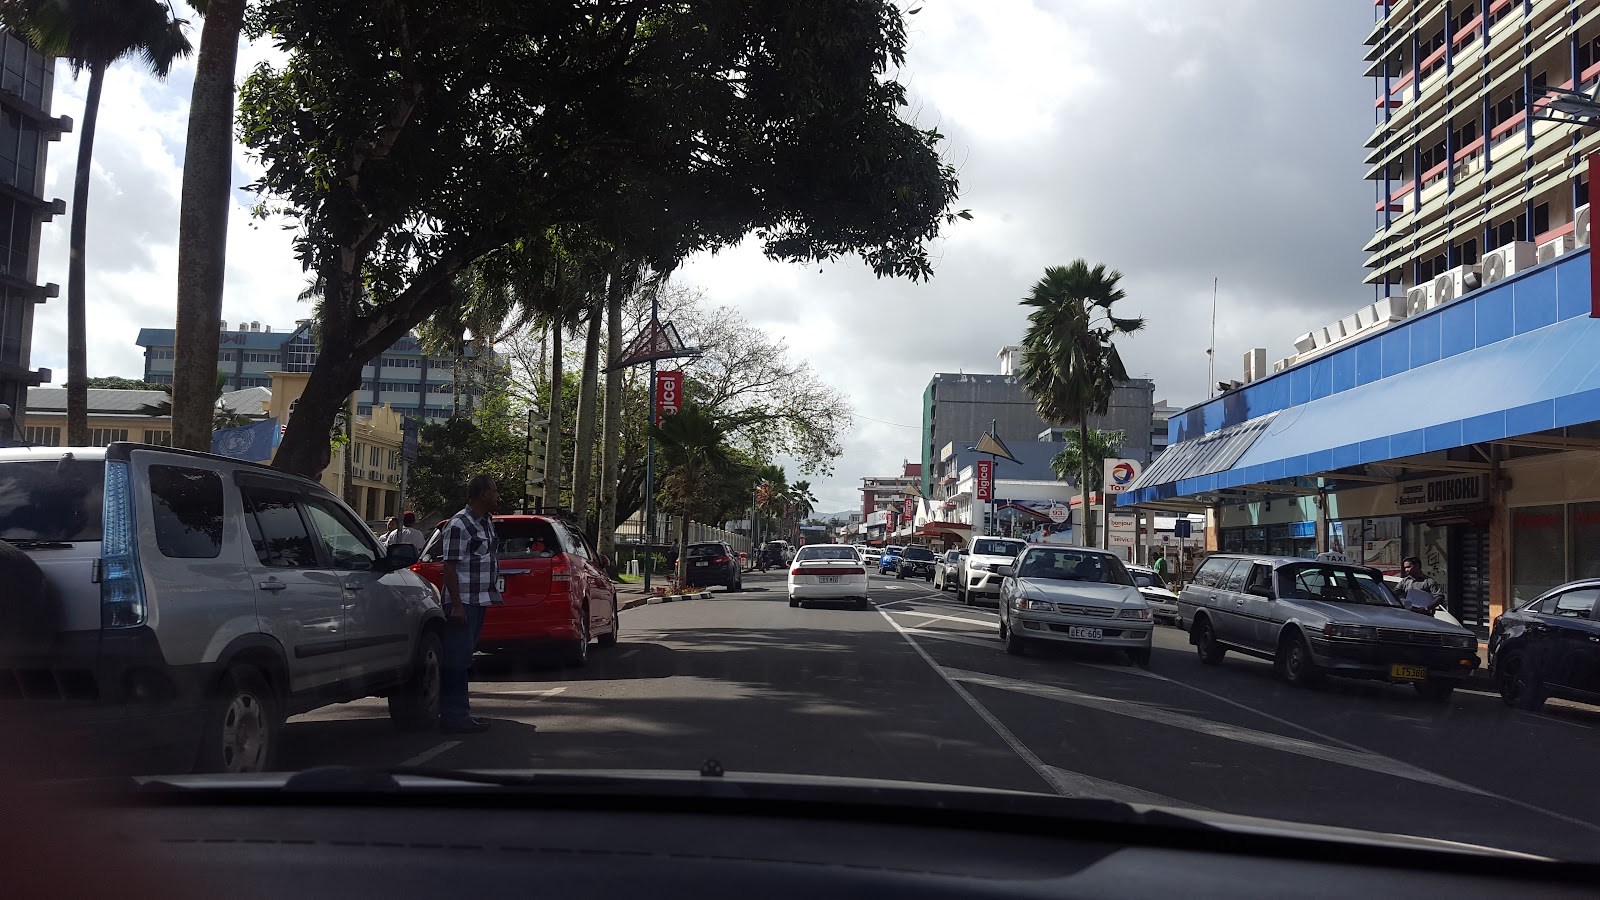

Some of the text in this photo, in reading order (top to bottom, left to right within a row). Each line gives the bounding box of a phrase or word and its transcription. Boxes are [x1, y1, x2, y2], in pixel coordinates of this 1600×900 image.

[979, 463, 989, 497] Digicel
[1427, 476, 1479, 502] DAIKOKU
[1111, 519, 1134, 528] bonjour
